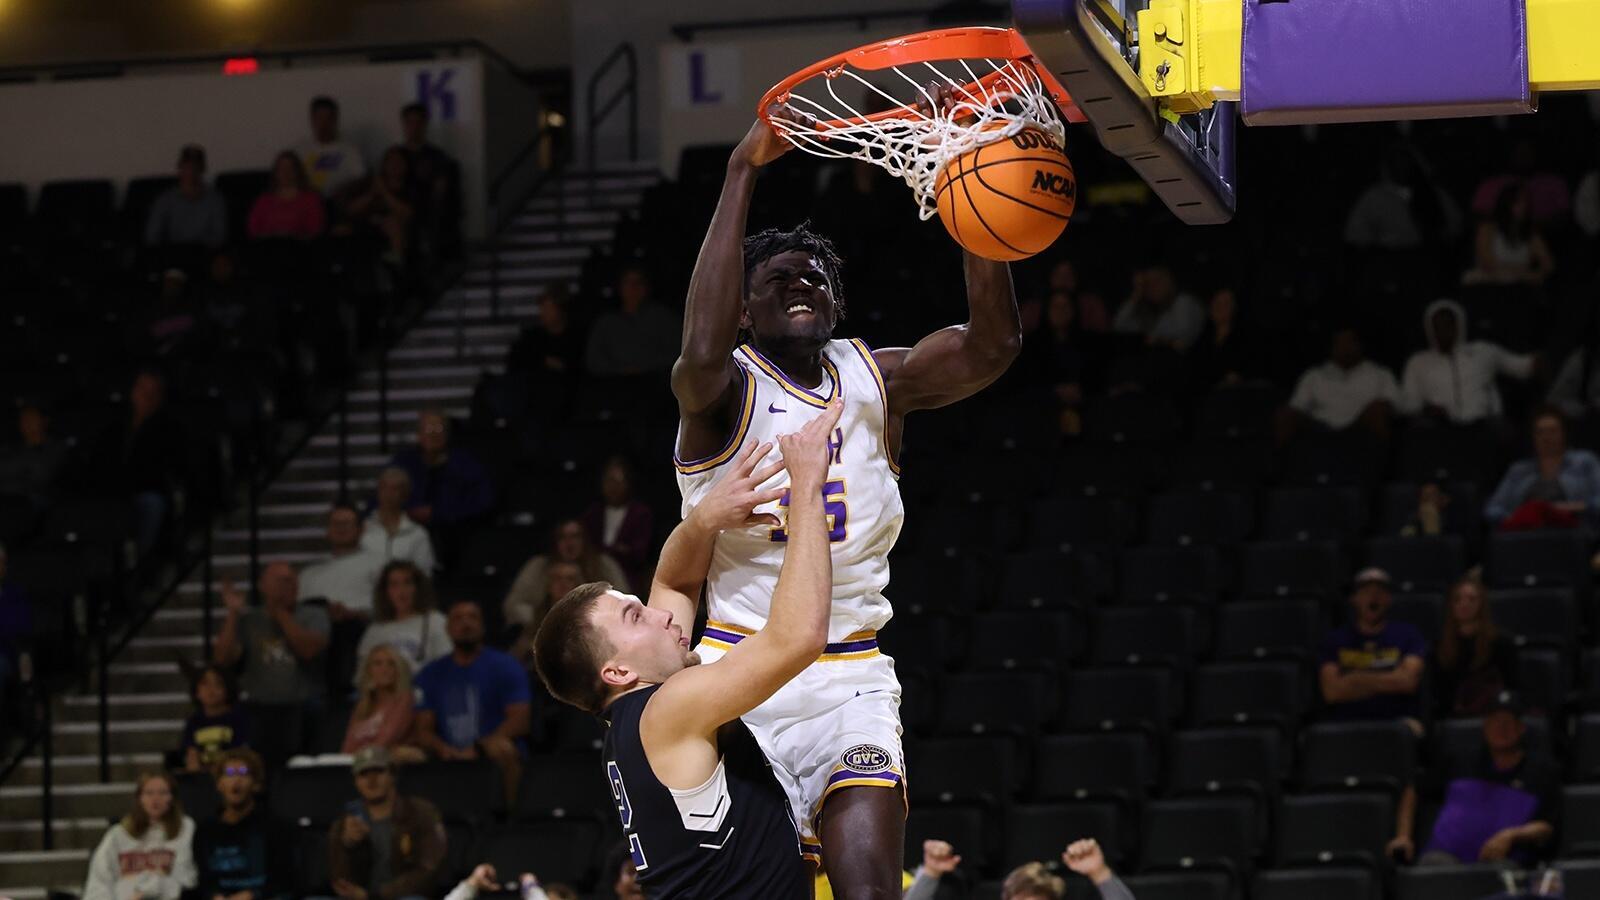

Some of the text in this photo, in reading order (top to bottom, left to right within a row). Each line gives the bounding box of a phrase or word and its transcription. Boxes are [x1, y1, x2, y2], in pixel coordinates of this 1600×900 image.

[416, 69, 456, 118] K
[690, 54, 721, 103] L
[852, 753, 880, 765] OVC
